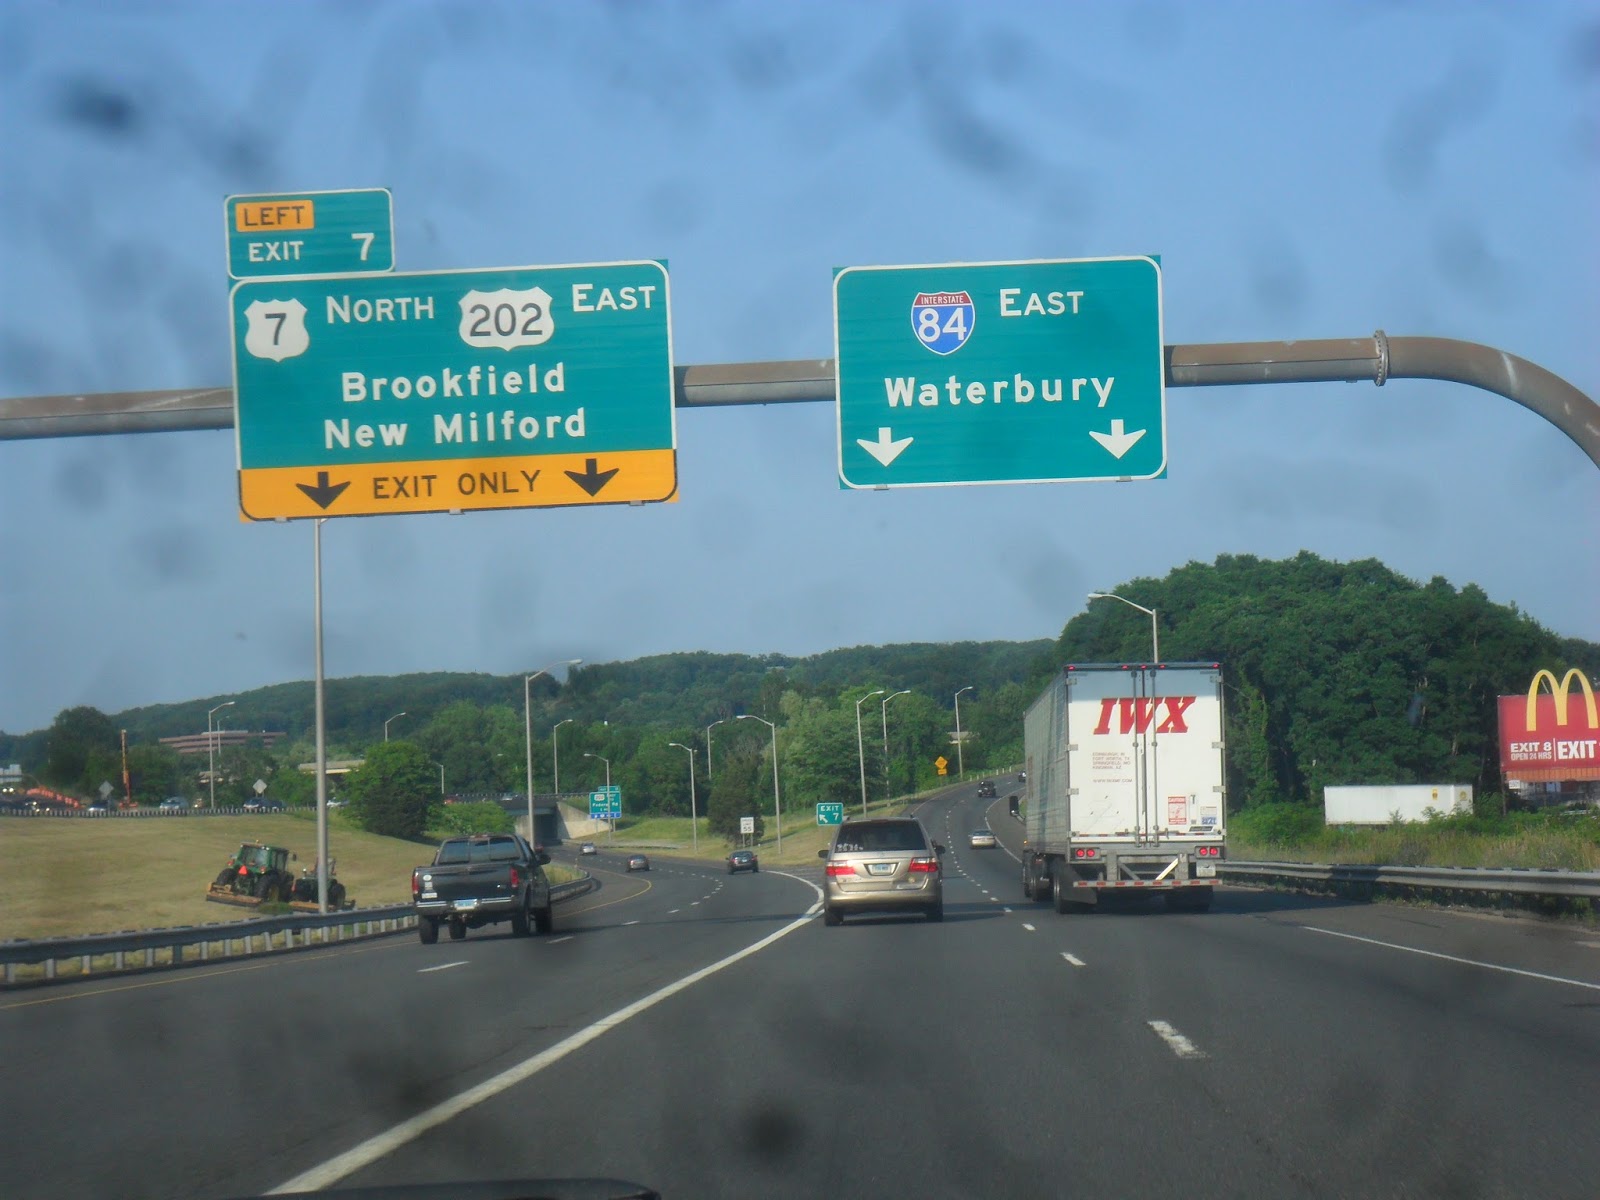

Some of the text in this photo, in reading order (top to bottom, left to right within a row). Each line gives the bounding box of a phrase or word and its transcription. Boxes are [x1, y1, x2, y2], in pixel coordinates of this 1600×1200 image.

[243, 205, 304, 226] LEFT
[248, 232, 375, 262] EXIT 7
[264, 283, 656, 346] 7 NORTH 202 EAST
[920, 294, 965, 306] INTERSTATE
[999, 288, 1084, 317] EAST
[918, 307, 967, 343] 84
[341, 361, 565, 402] Brookfield
[884, 372, 1115, 408] Waterbury
[323, 406, 586, 449] New Milford
[373, 469, 541, 499] EXIT ONLY
[1093, 696, 1197, 735] IWX
[1510, 741, 1552, 753] EXIT 8
[1510, 751, 1552, 761] OPEN 24 HRS
[1557, 740, 1597, 760] EXIT
[833, 812, 839, 820] 7
